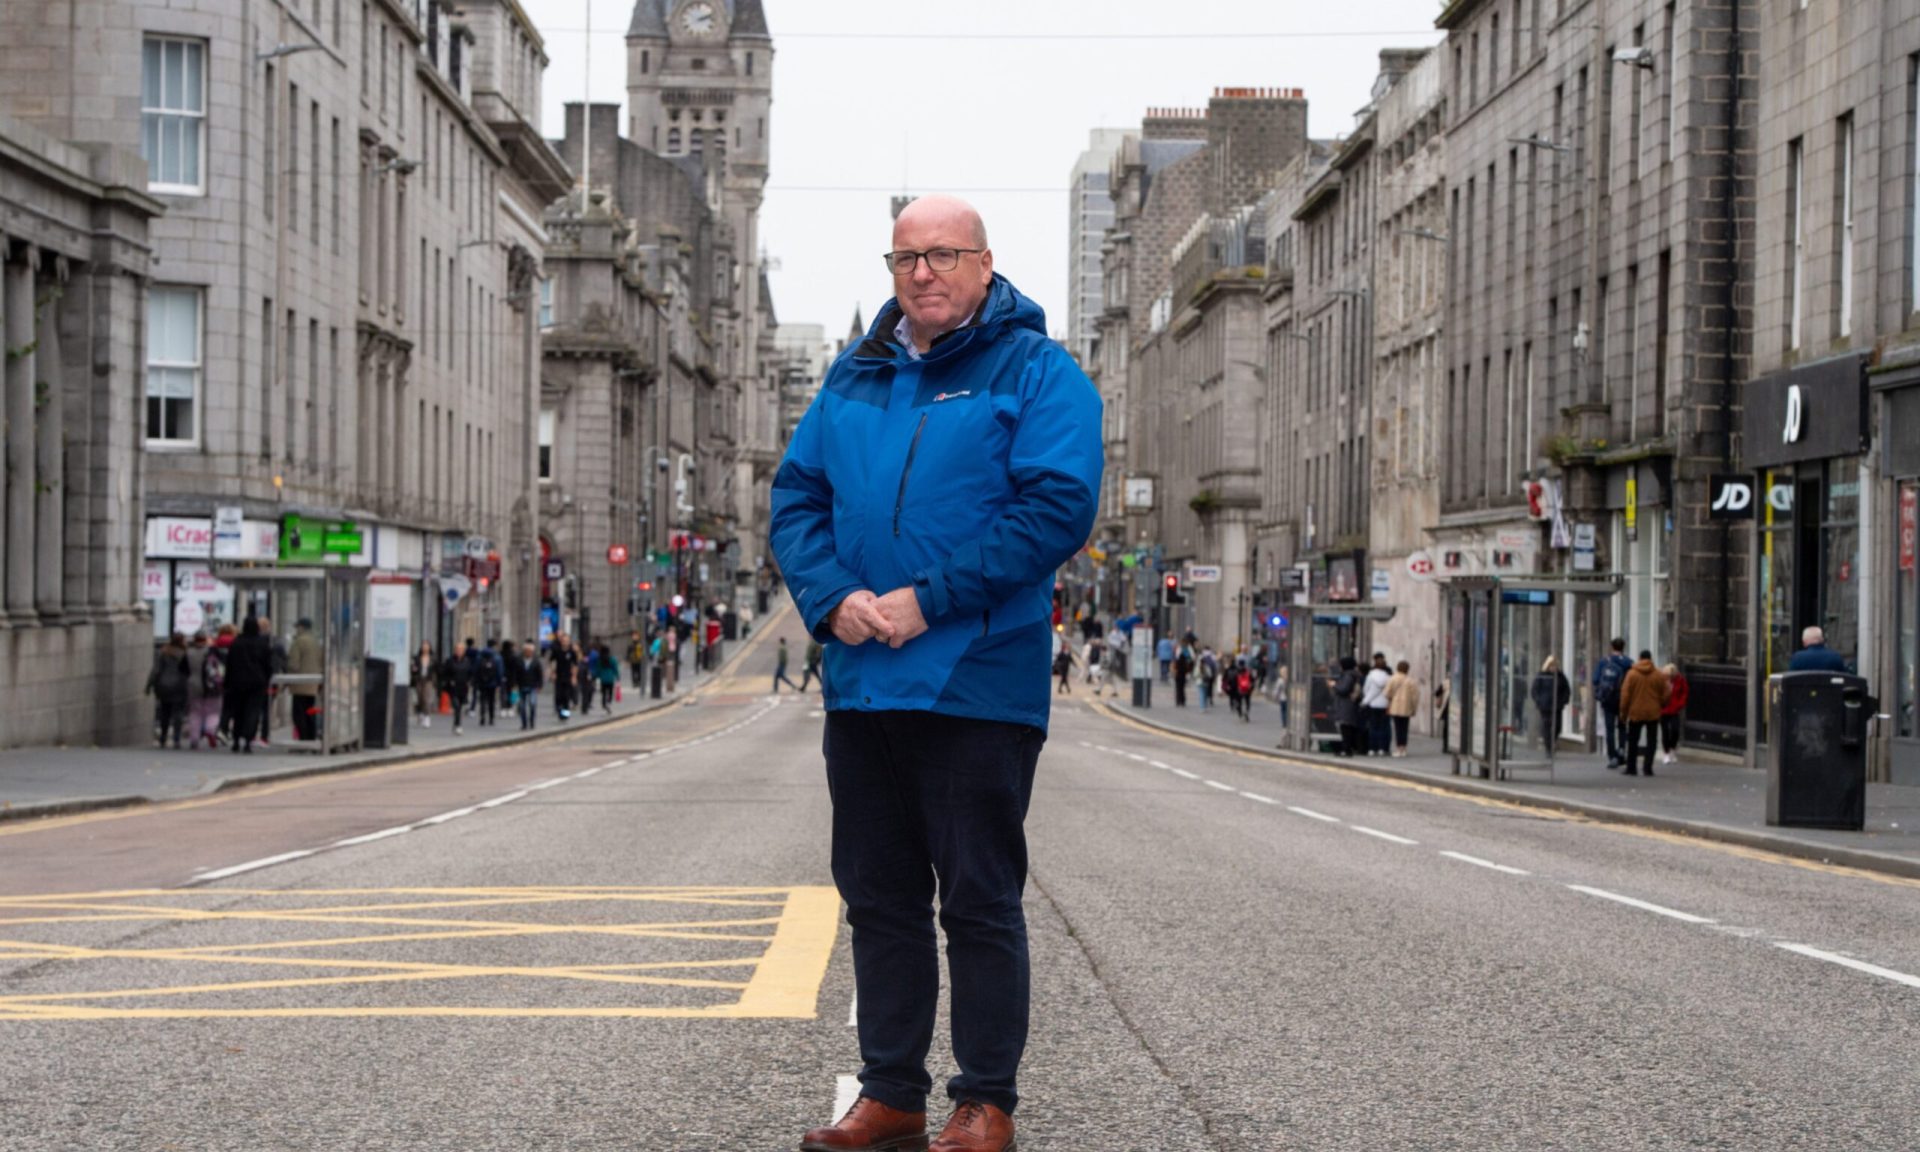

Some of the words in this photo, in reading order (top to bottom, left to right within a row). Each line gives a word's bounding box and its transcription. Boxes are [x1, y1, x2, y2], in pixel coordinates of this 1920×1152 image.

[1783, 384, 1801, 444] JD
[1712, 483, 1751, 511] JD
[167, 523, 212, 544] iCrac
